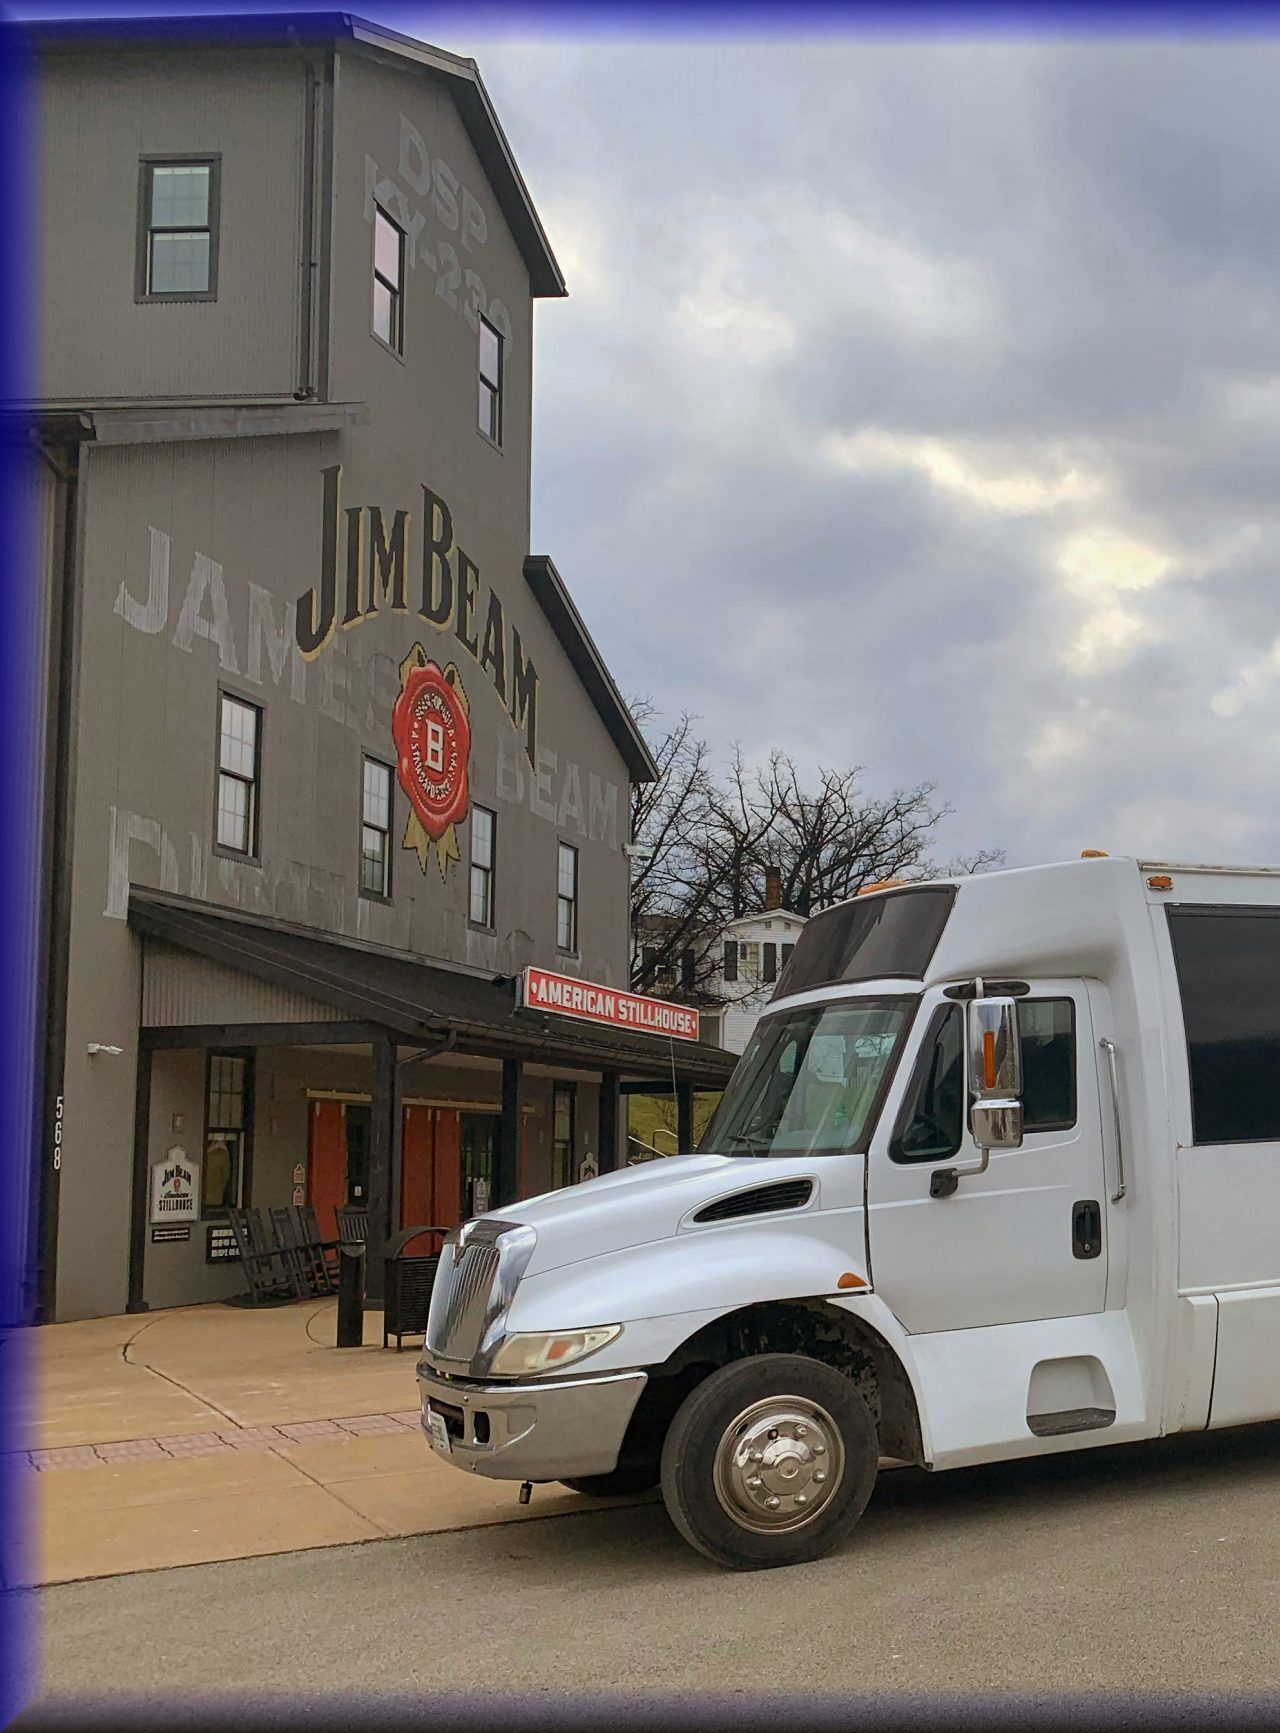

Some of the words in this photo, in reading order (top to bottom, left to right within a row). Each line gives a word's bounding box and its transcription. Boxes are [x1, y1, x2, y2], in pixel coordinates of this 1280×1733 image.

[398, 111, 488, 252] DSP
[295, 464, 411, 663] JIM
[417, 483, 540, 777] BEAM
[425, 718, 444, 773] B
[537, 978, 615, 1019] AMERICAN
[617, 999, 692, 1034] STILLHOUSE
[53, 1096, 64, 1170] 568
[175, 1165, 192, 1186] BEAM
[158, 1199, 193, 1211] STILLHOUSE
